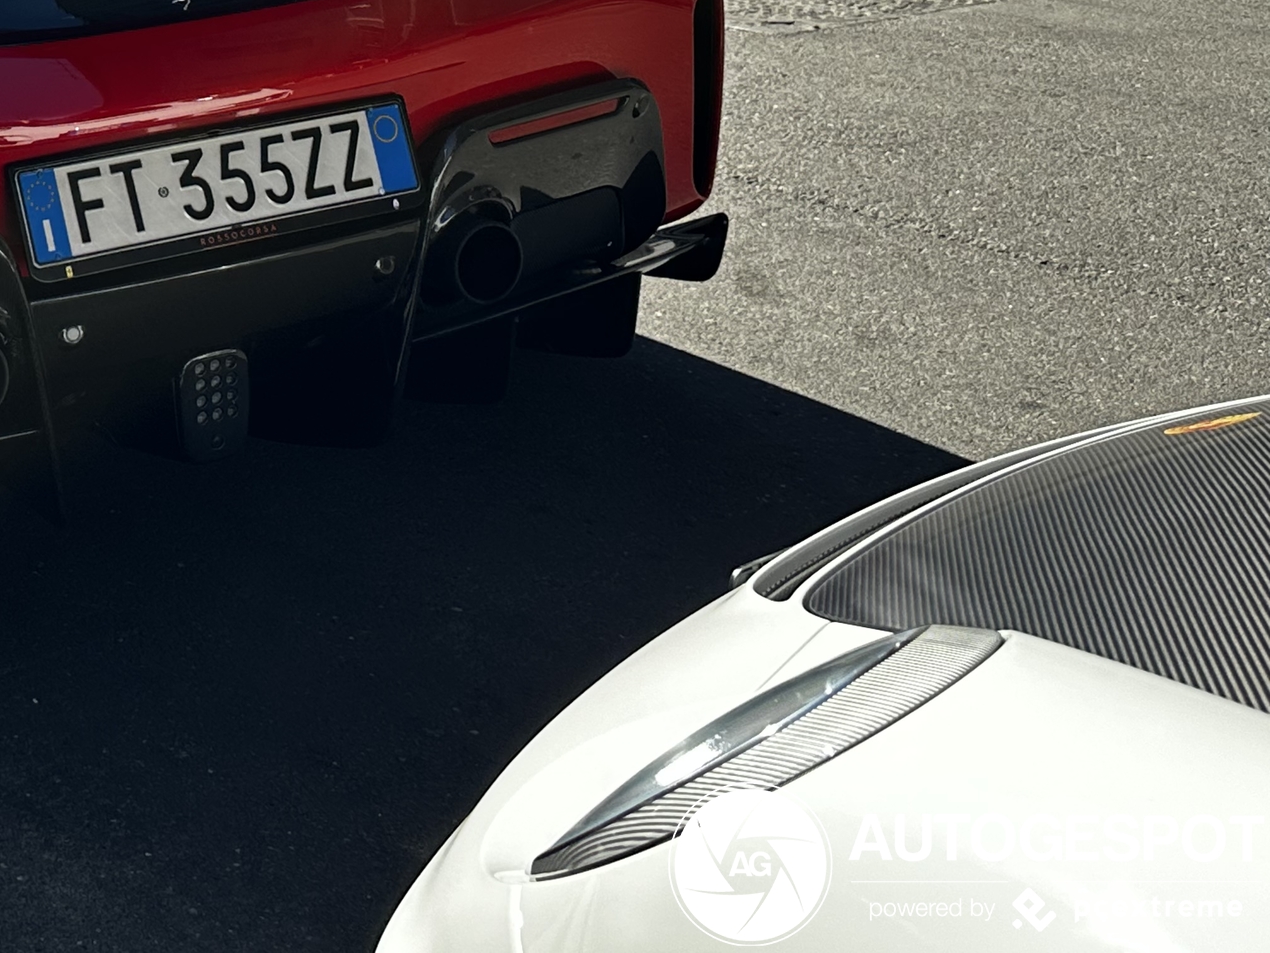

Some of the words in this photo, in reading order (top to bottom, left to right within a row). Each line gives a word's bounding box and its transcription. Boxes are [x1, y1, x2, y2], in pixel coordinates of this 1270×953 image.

[66, 158, 146, 245] FT
[170, 119, 375, 222] 355ZZ
[199, 223, 278, 246] ROSSOCORSA
